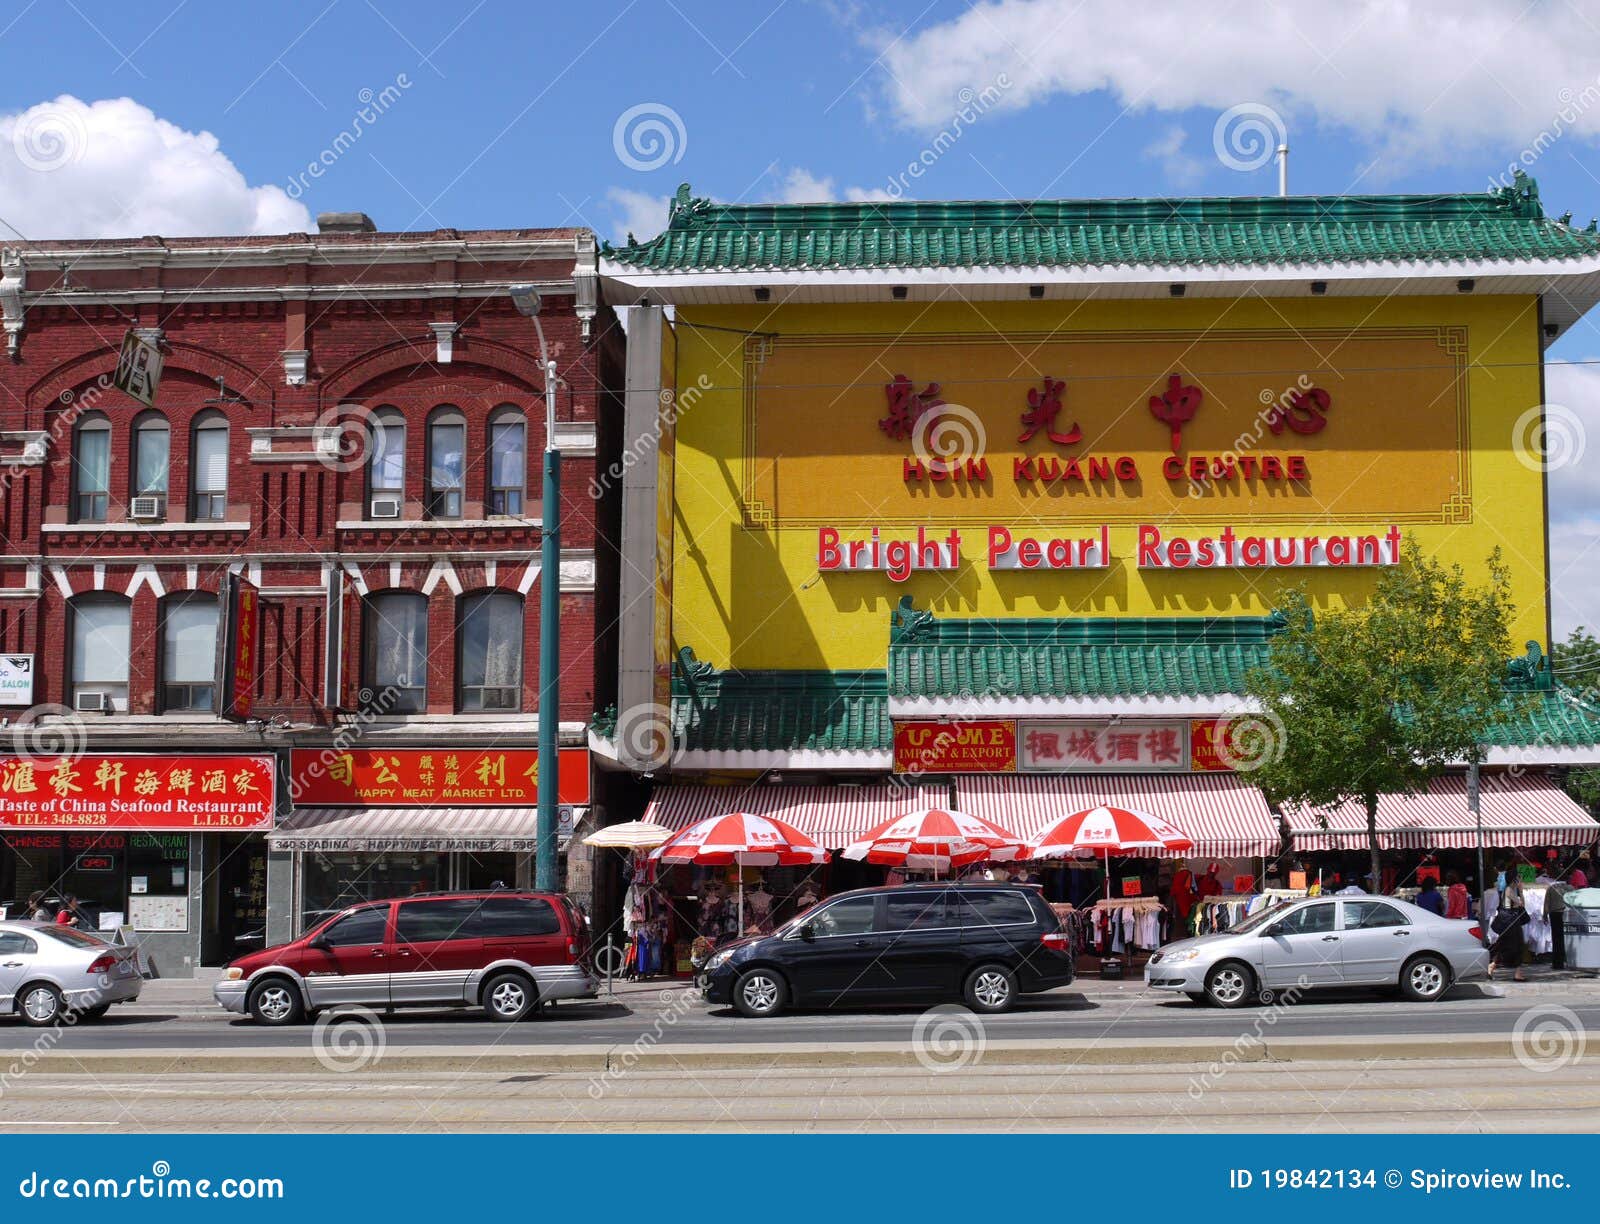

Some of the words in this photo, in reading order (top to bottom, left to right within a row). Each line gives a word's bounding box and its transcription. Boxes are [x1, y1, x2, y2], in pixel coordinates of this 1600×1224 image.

[903, 456, 988, 482] HSIN
[1013, 456, 1137, 481] KUANG
[1162, 455, 1306, 481] CENTRE
[817, 526, 961, 582] Bright
[987, 526, 1110, 570] Pearl
[1137, 524, 1401, 568] Restaurant
[2, 679, 30, 689] SALON
[900, 747, 947, 759] IMPORT
[950, 748, 959, 758] &
[962, 747, 1011, 758] EXPORT
[354, 788, 396, 798] HAPPY
[403, 788, 435, 798] MEAT
[443, 788, 494, 798] MARKET
[501, 788, 526, 798] LTD.
[41, 799, 56, 813] of
[59, 799, 107, 813] China
[110, 799, 173, 813] Seafood
[177, 799, 264, 814] Restaurant
[15, 814, 48, 825] TEL:
[51, 814, 107, 825] 348-8828
[192, 814, 245, 826] L.L.B.O
[6, 835, 62, 848] CHINESE
[67, 835, 124, 848] SEAFOOD
[130, 835, 188, 848] RESTAURANT
[300, 840, 349, 849] SPADINA
[368, 840, 406, 849] HAPPY
[411, 840, 441, 849] MEAT
[446, 840, 496, 849] MARKET
[82, 859, 108, 868] OPEN
